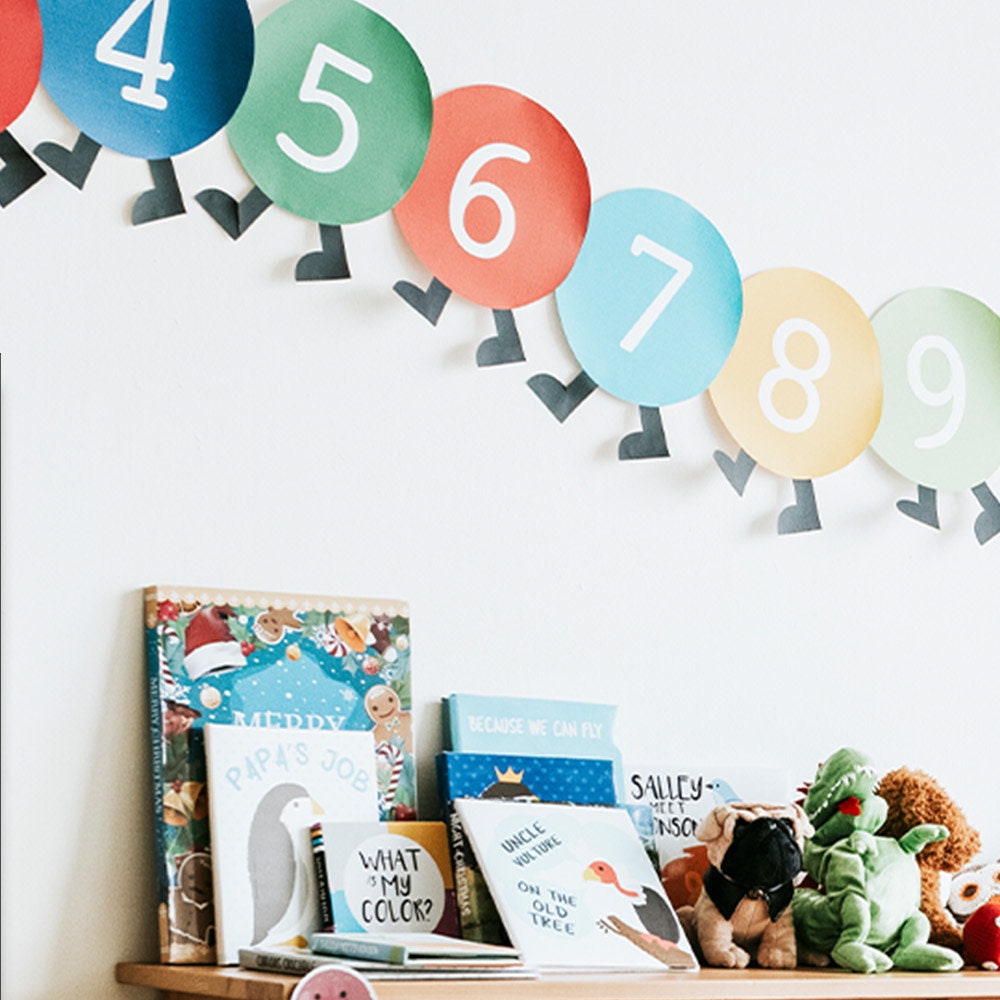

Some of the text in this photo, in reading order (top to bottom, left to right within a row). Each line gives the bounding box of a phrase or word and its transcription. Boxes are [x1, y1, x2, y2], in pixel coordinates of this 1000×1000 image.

[95, 0, 175, 110] 4
[275, 42, 373, 173] 5
[449, 142, 531, 260] 6
[620, 233, 694, 353] 7
[758, 318, 832, 434] 8
[907, 334, 967, 450] 9
[468, 715, 603, 739] BECAUSE WE CAN FLY
[225, 742, 370, 793] PAPA'S JOB
[631, 774, 703, 801] SALLEY
[501, 820, 546, 853] UNCLE
[512, 834, 562, 868] VULTURE
[358, 848, 421, 871] WHAT
[517, 880, 577, 907] ON THE
[532, 899, 568, 918] OLD
[361, 898, 433, 923] COLOR?
[528, 911, 575, 936] TREE
